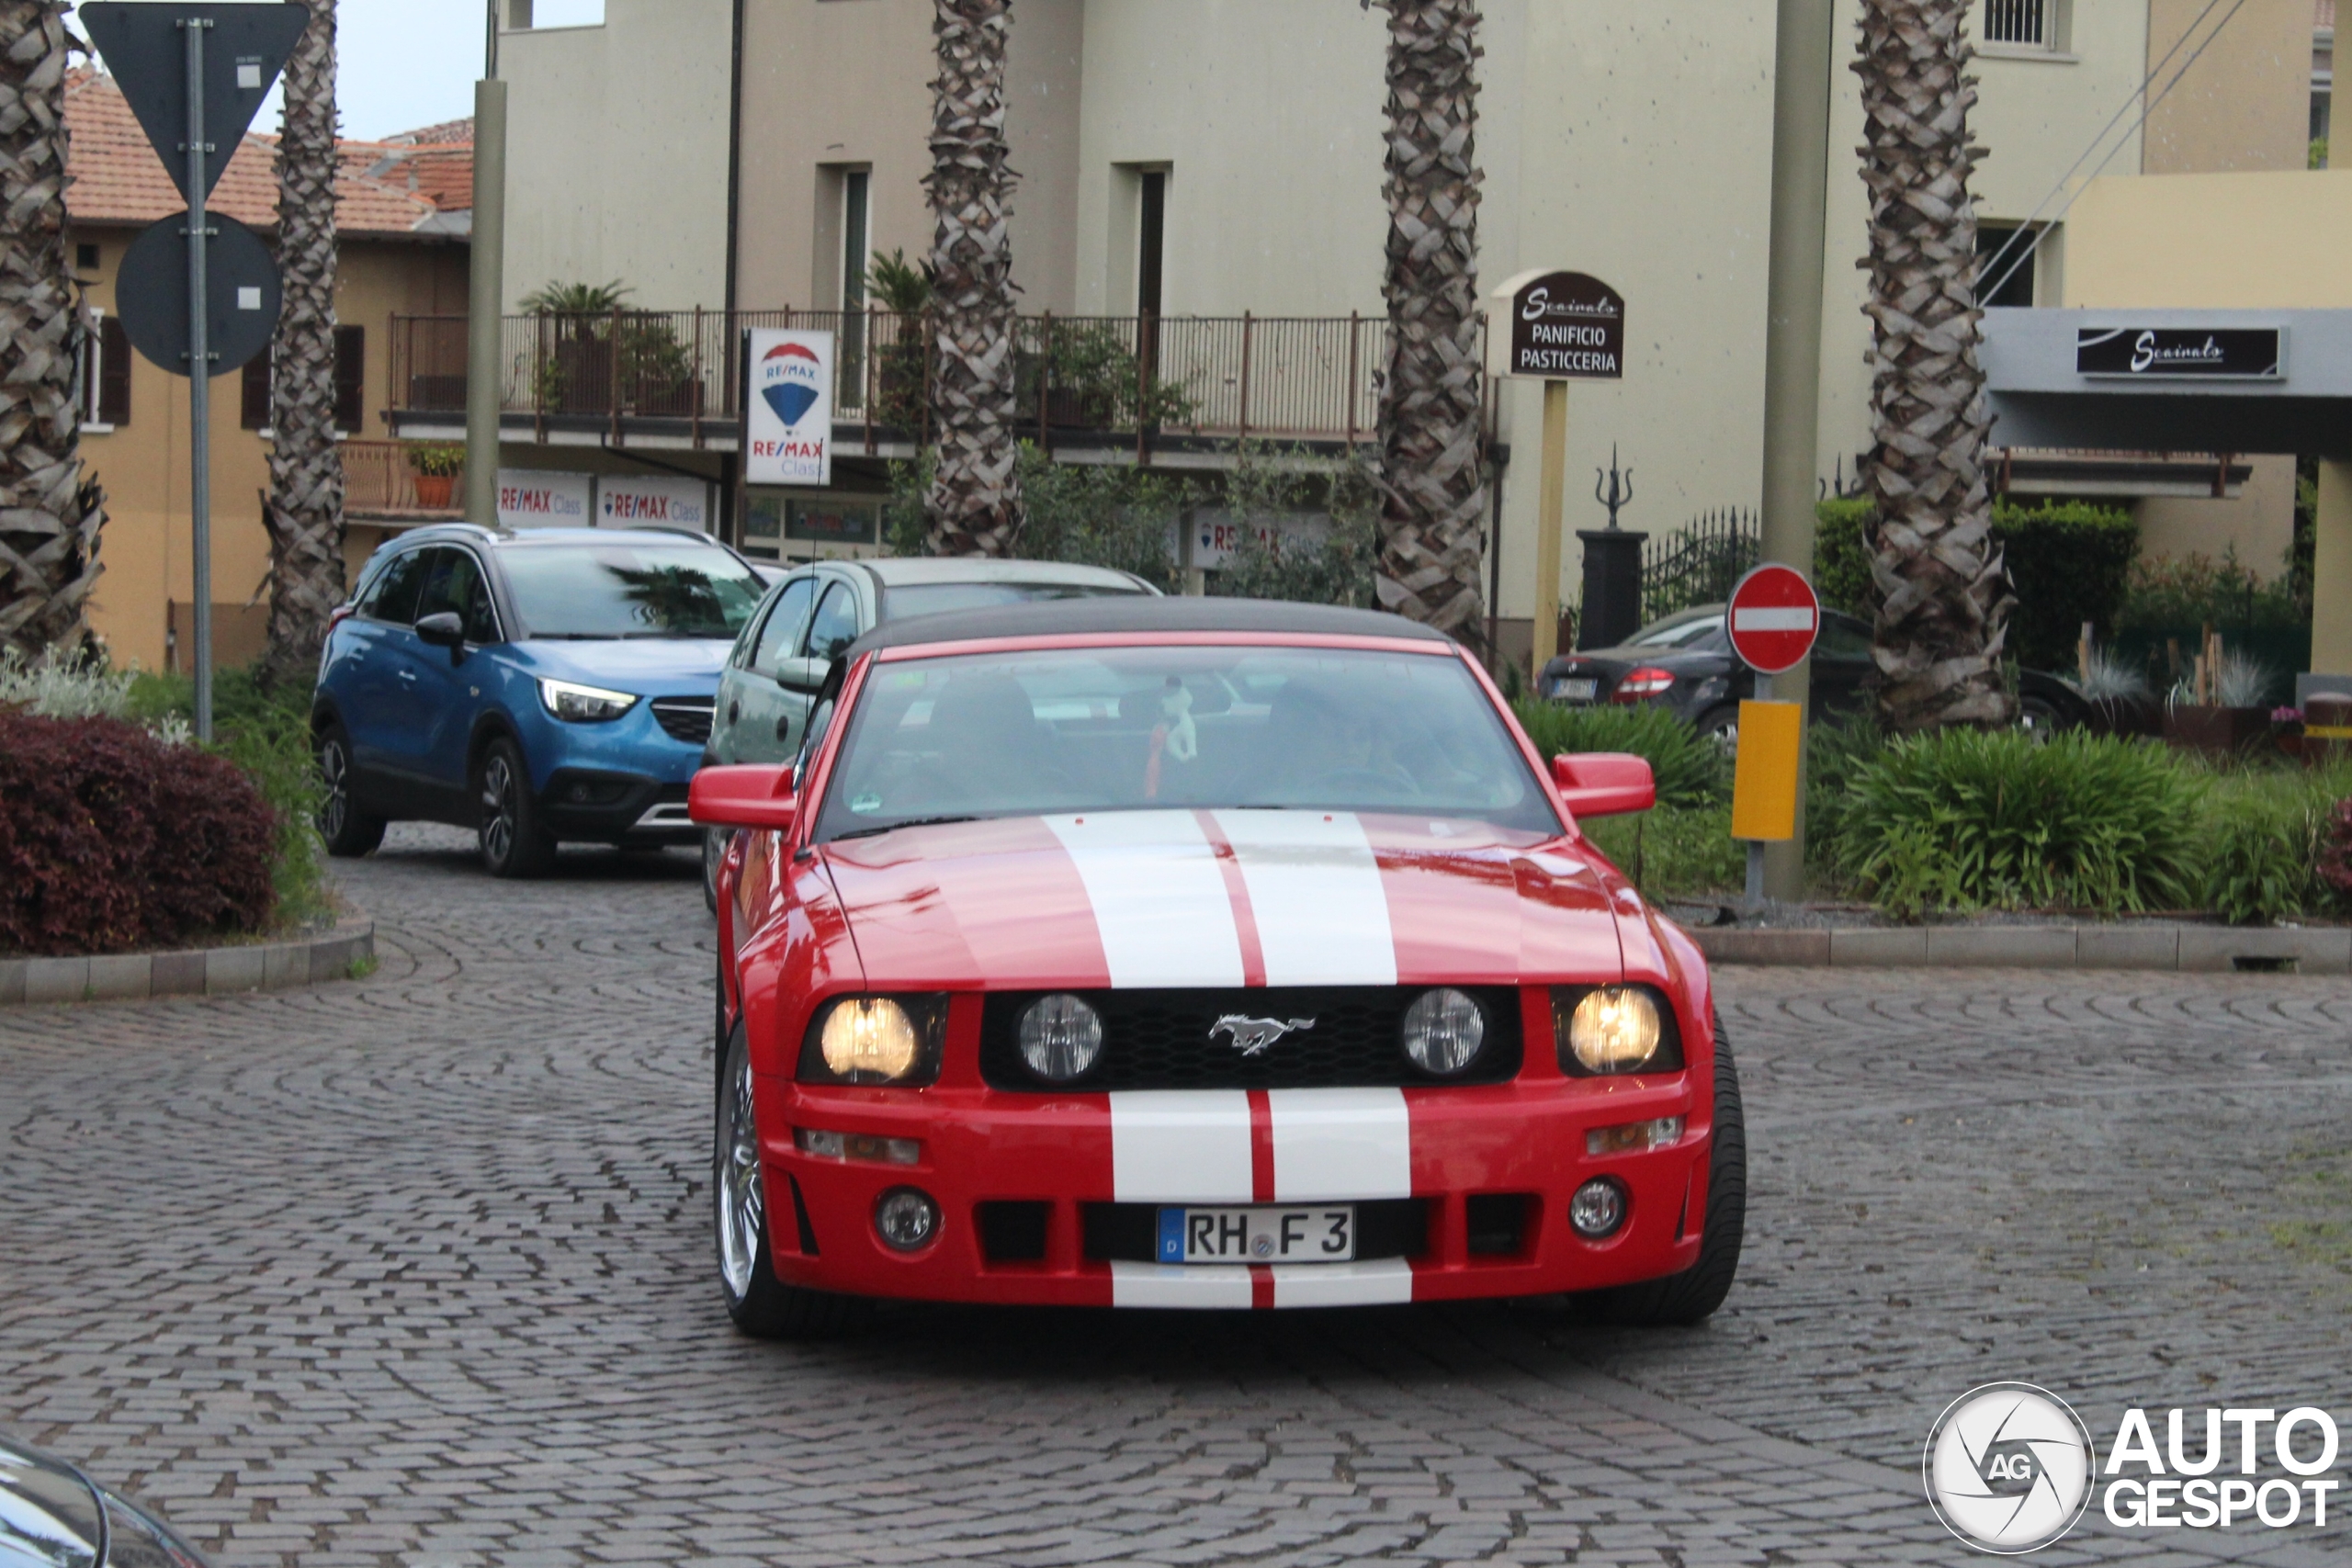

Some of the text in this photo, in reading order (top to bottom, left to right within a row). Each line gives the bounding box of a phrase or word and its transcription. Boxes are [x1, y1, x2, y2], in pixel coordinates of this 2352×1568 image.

[1532, 323, 1606, 346] PANIFICIO
[1521, 348, 1616, 372] PASTICCERIA
[766, 364, 816, 380] RE/MAX
[752, 441, 823, 458] RE/MAX
[781, 460, 824, 476] Class
[501, 488, 581, 515] RE/MAX Class
[615, 492, 700, 522] RE/MAX Class
[1188, 1213, 1348, 1255] RH F 3
[1166, 1240, 1177, 1254] D
